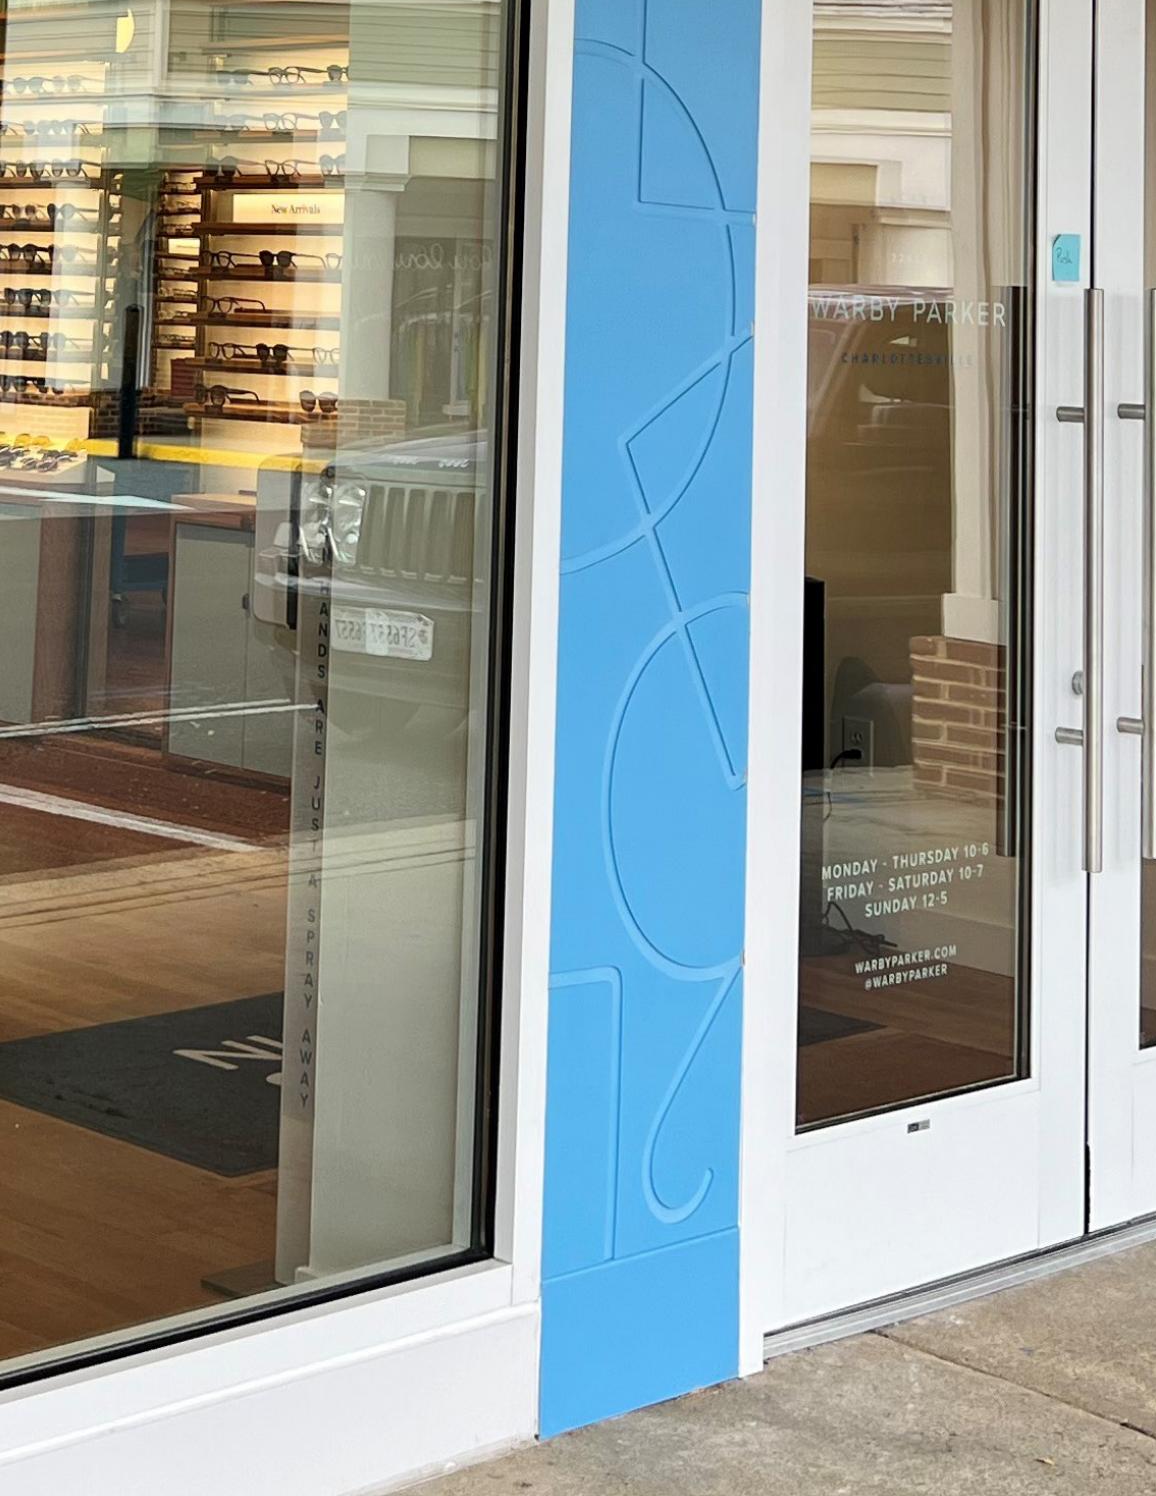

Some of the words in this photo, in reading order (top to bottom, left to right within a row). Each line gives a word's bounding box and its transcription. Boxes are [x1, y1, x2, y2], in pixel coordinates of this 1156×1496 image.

[812, 295, 900, 322] WARBY
[913, 299, 1006, 328] PARKER
[315, 698, 326, 756] ARE
[821, 859, 877, 881] MONDAY
[893, 847, 959, 869] THURSDAY
[964, 842, 989, 858] 10-6
[826, 881, 875, 903] FRIDAY
[888, 870, 954, 892] SATURDAY
[959, 863, 984, 880] 10-7
[865, 897, 917, 918] SUNDAY
[922, 890, 948, 909] 12-5
[304, 908, 316, 1009] SPRAY
[854, 945, 956, 974] WARBYPARKER.COM
[865, 964, 948, 990] @WARBYPARKER
[299, 1029, 313, 1108] AWAY
